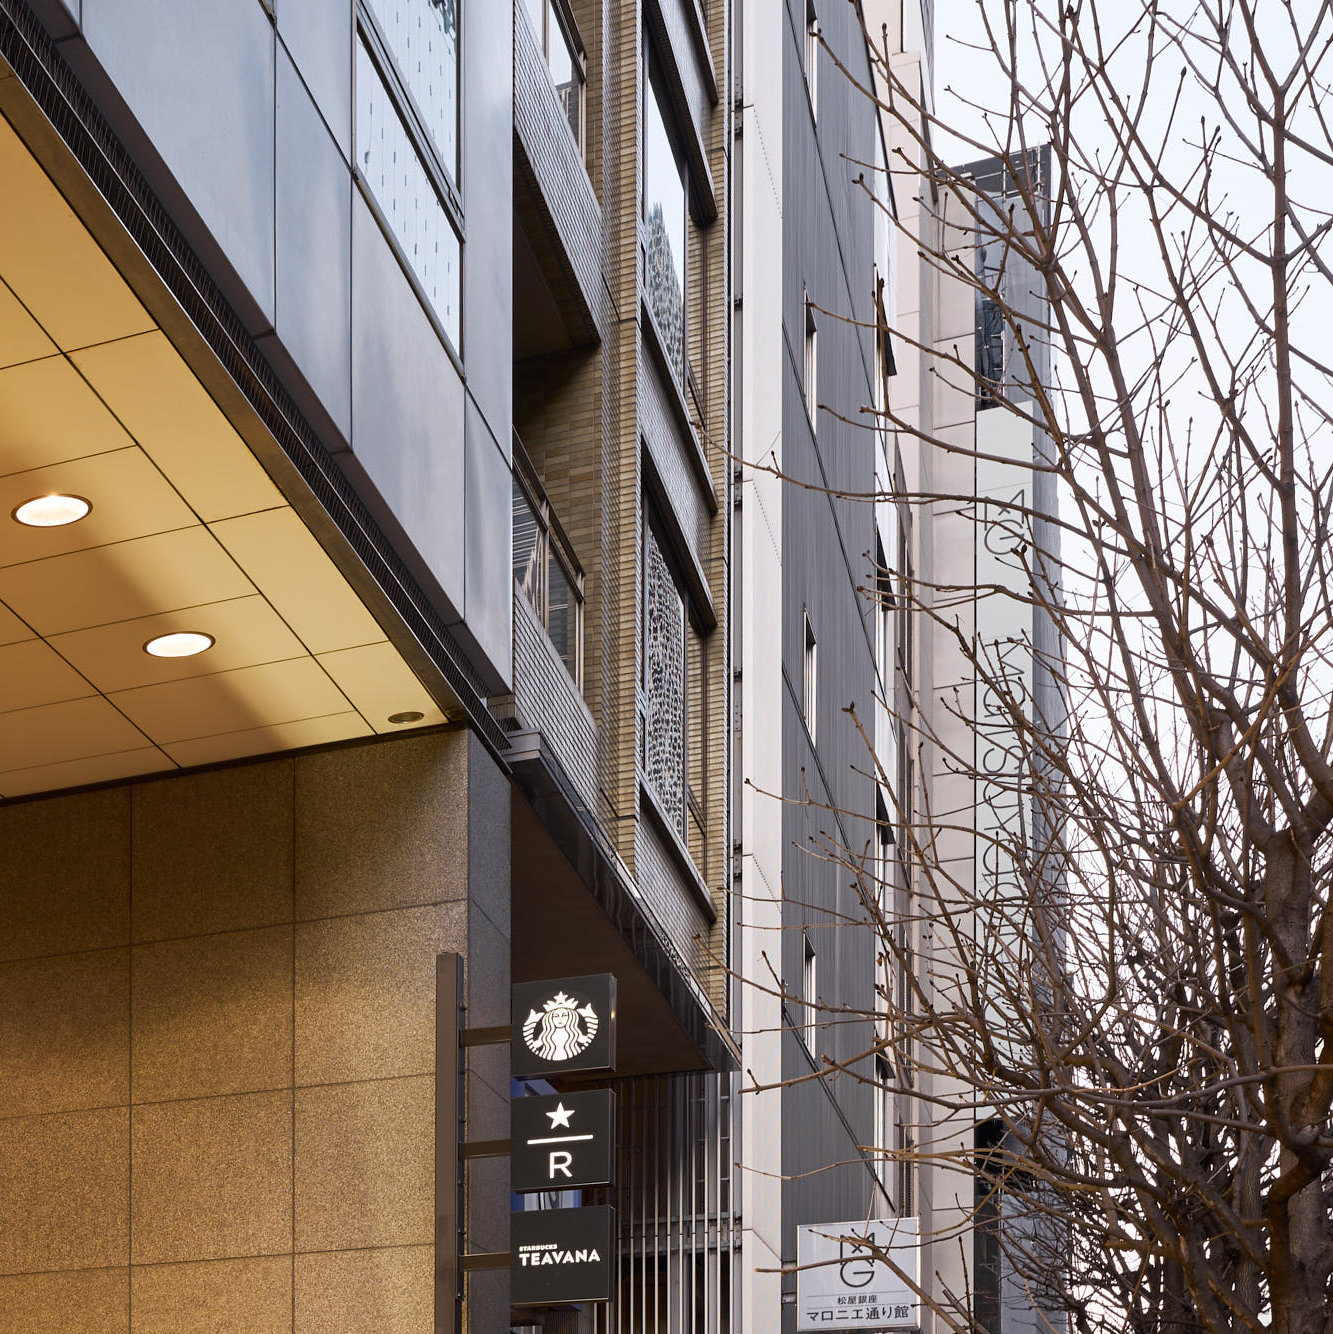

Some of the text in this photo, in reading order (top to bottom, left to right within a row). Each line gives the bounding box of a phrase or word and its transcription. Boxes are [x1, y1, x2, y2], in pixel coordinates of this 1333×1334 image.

[549, 1151, 573, 1179] R
[519, 1243, 558, 1252] STARBUCKS
[518, 1248, 601, 1267] TEAVANA
[836, 1294, 878, 1305] 松屋銀座
[805, 1305, 910, 1321] マロニエ通り館
